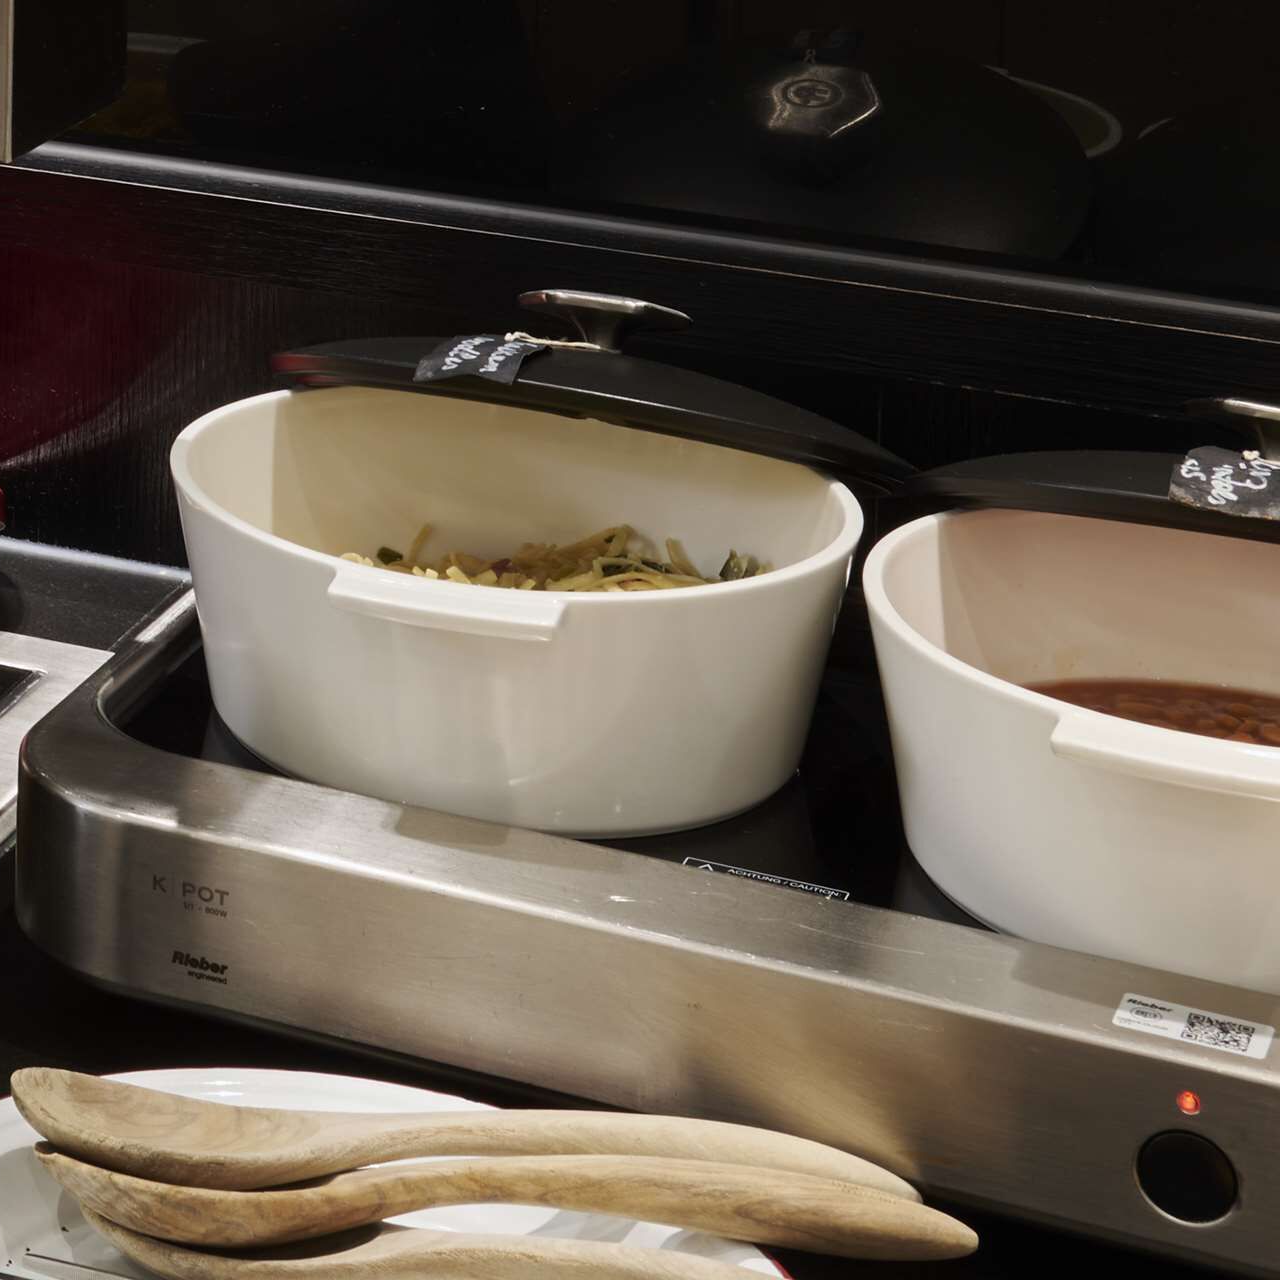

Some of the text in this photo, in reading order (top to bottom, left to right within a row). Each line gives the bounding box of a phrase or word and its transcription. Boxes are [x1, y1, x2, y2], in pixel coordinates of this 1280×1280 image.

[153, 874, 230, 906] K POT
[727, 868, 782, 884] ACHTUNG
[790, 882, 840, 897] CAUTION
[172, 950, 228, 975] Rieber
